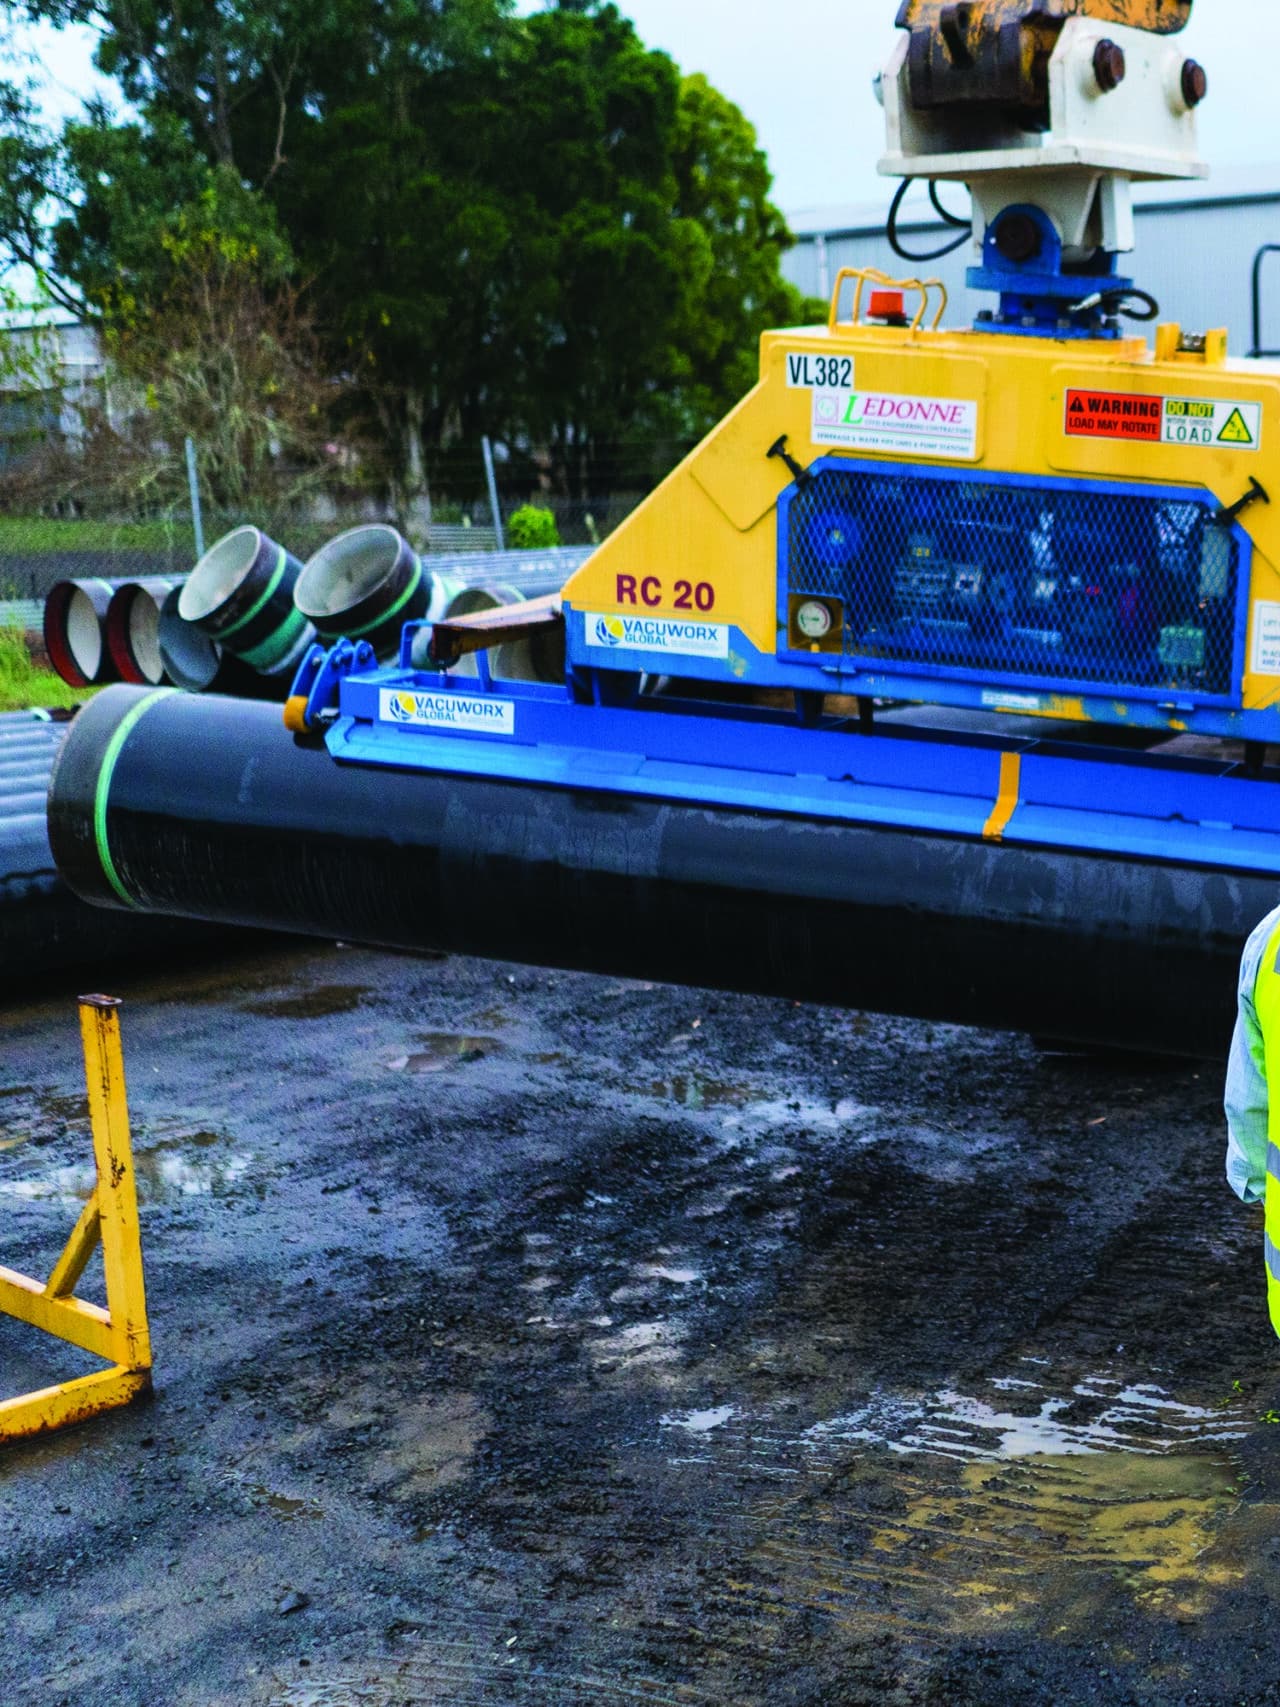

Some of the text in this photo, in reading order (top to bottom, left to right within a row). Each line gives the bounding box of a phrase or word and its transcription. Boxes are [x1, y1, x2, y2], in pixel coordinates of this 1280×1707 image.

[789, 355, 851, 387] VL382
[841, 395, 966, 424] LEDONNE
[1087, 397, 1159, 417] WARNING
[1166, 401, 1213, 416] DO NOT
[1069, 417, 1158, 434] LOAD MAY ROTATE
[1166, 426, 1212, 443] LOAD
[616, 573, 715, 612] RC 20
[623, 619, 718, 641] VACUWORX
[624, 633, 668, 646] GLOBAL
[415, 696, 504, 718] VACUWORX
[416, 710, 457, 722] GLOBAL
